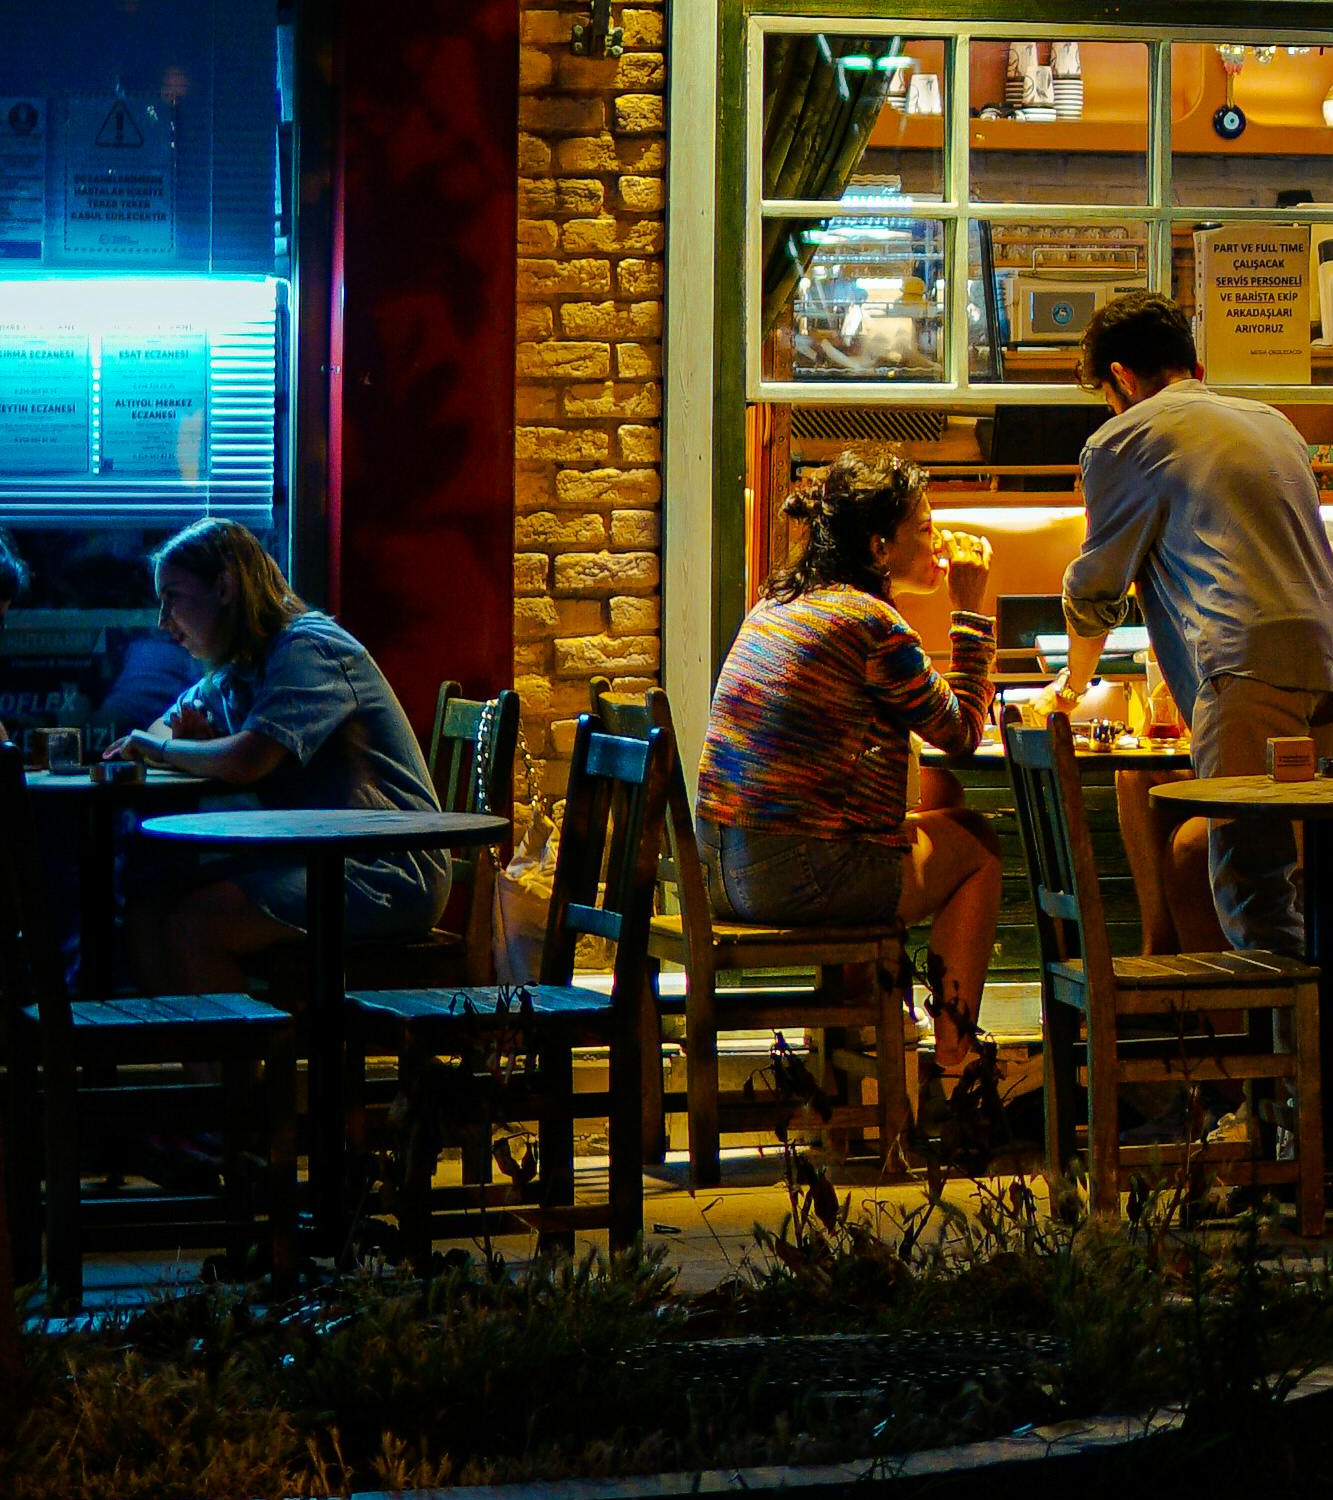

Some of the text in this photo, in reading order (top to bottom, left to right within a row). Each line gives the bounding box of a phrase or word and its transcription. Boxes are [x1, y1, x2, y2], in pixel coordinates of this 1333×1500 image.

[1213, 243, 1304, 253] PART VE FULL TIME
[1233, 259, 1285, 271] ÇALIŞACAK
[1251, 274, 1302, 286] PERSONELİ
[1220, 291, 1298, 302] VE BARİSTA EKİP
[1226, 308, 1292, 319] ARKADAŞLARI
[1235, 324, 1284, 333] ARIYORUZ
